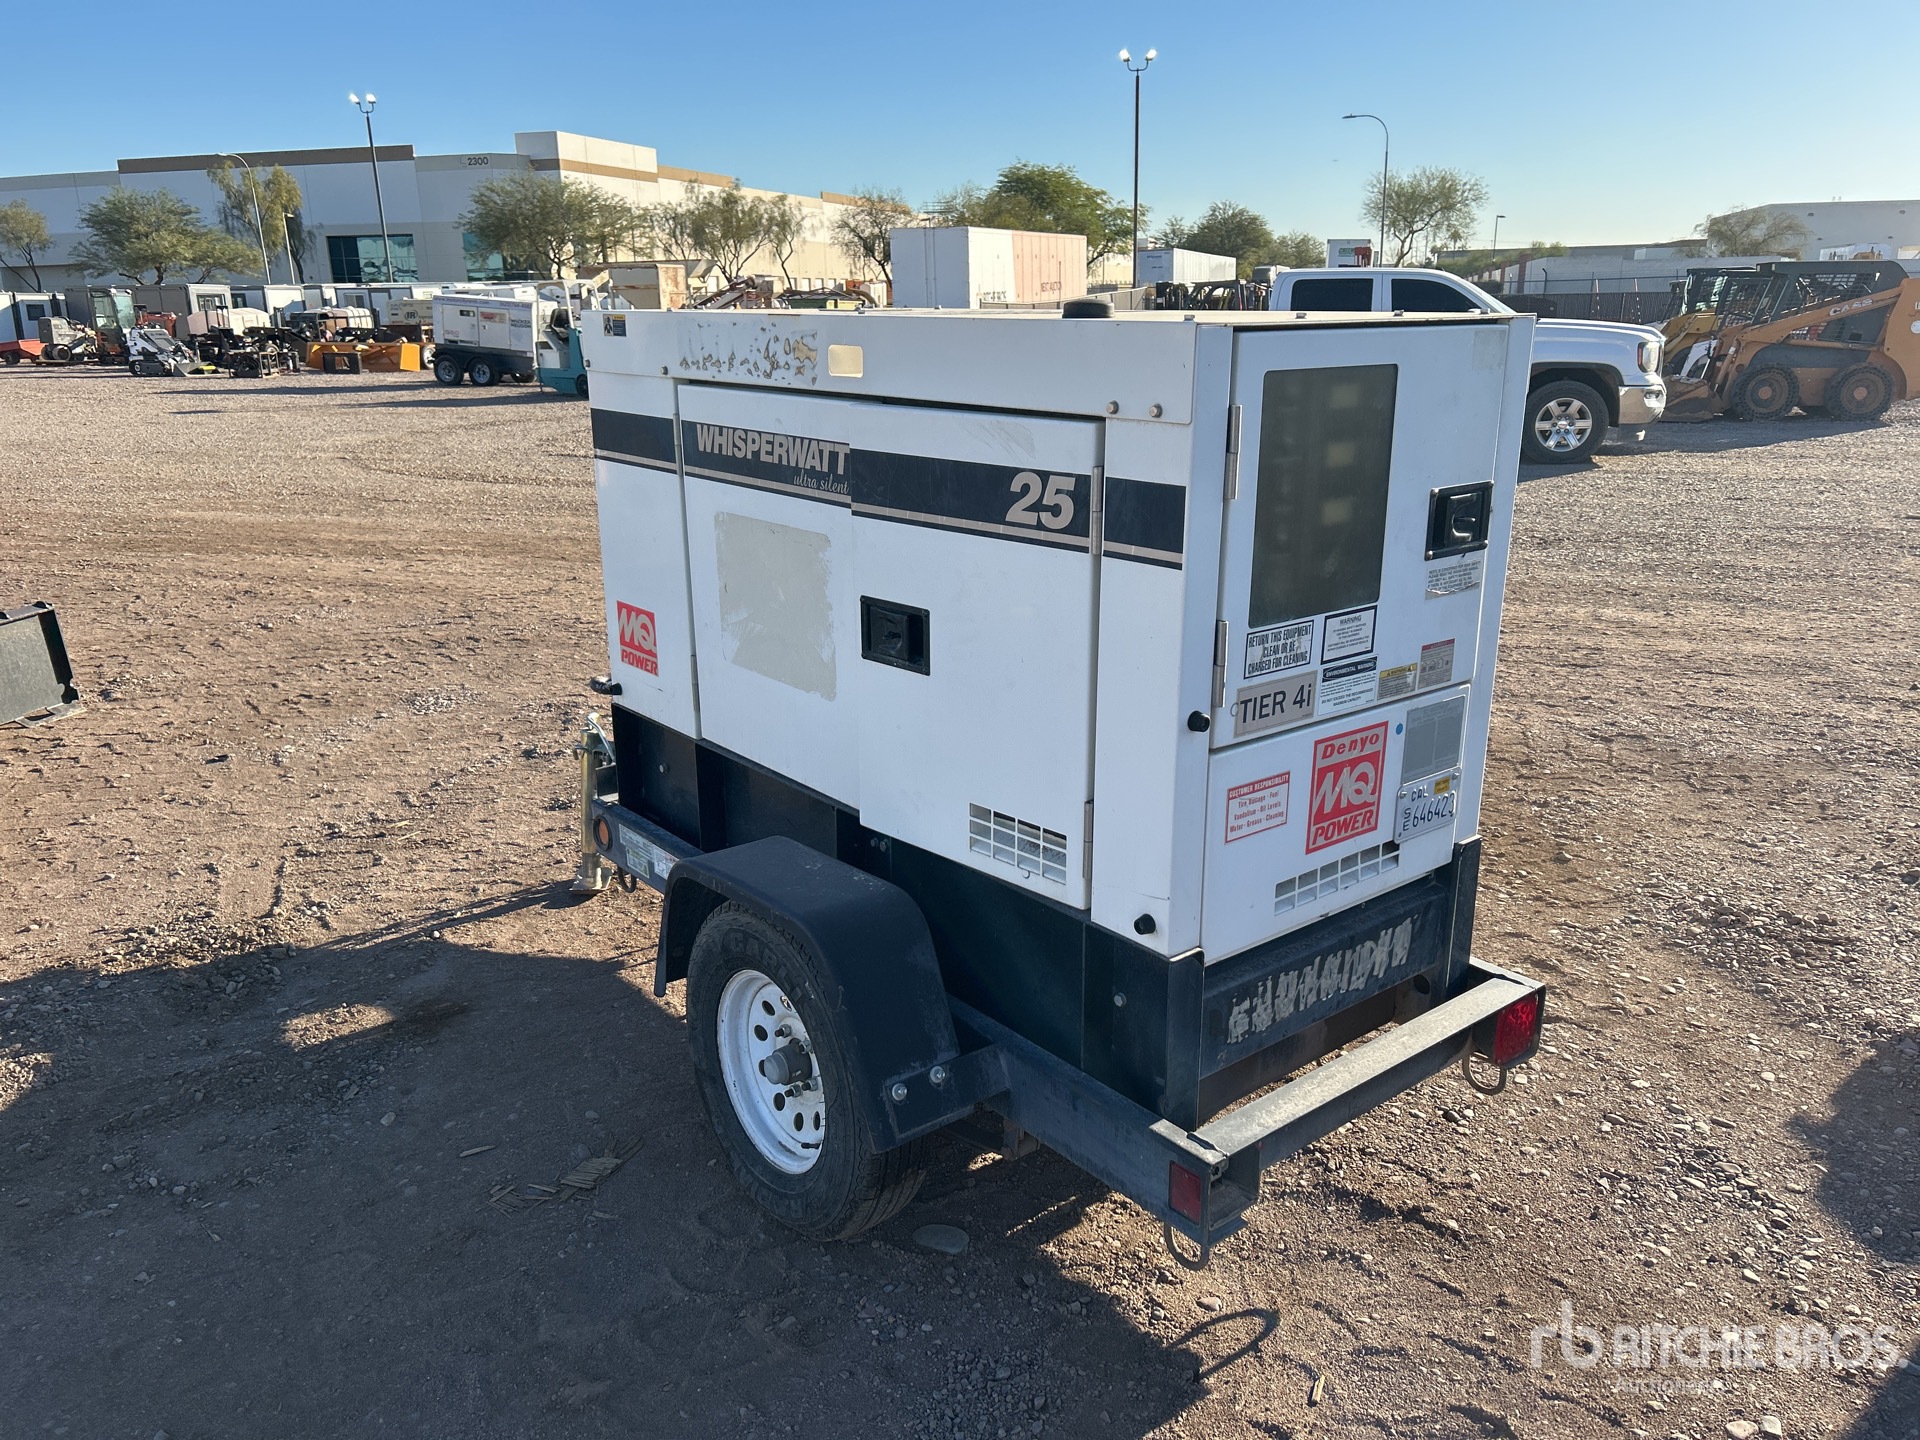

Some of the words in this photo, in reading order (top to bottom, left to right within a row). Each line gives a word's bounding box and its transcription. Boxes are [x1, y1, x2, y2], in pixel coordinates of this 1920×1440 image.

[467, 157, 489, 166] 2300
[1830, 298, 1873, 316] CASE
[697, 424, 850, 475] WHISPERWATT
[793, 469, 818, 489] ultra
[819, 473, 850, 494] silent
[1005, 471, 1076, 530] 25
[618, 608, 657, 653] MQ
[1339, 615, 1361, 625] WARNING
[1248, 633, 1269, 648] RETURN
[1271, 630, 1282, 643] THIS
[1283, 625, 1311, 640] EQUIPMENT
[1263, 644, 1280, 658] CLEAN
[1281, 643, 1288, 654] OR
[1289, 640, 1296, 652] BE
[621, 649, 658, 676] POWER
[1248, 659, 1271, 675] CHARGED
[1272, 656, 1283, 669] FOR
[1283, 650, 1308, 666] CLEANING
[1325, 665, 1356, 677] ENVIRONMENTAL
[1240, 690, 1286, 723] TIER
[1293, 683, 1312, 709] 4i
[1321, 733, 1380, 760] Denyo
[1230, 785, 1253, 798] CUSTOMER
[1254, 775, 1289, 790] RESPONSIBILITY
[1312, 761, 1377, 814] MQ
[1234, 809, 1256, 821] Vandalism
[1238, 801, 1247, 809] Tire
[1230, 824, 1244, 833] Water
[1247, 818, 1262, 828] Grease
[1265, 811, 1284, 821] Cleaning
[1312, 809, 1374, 846] POWER
